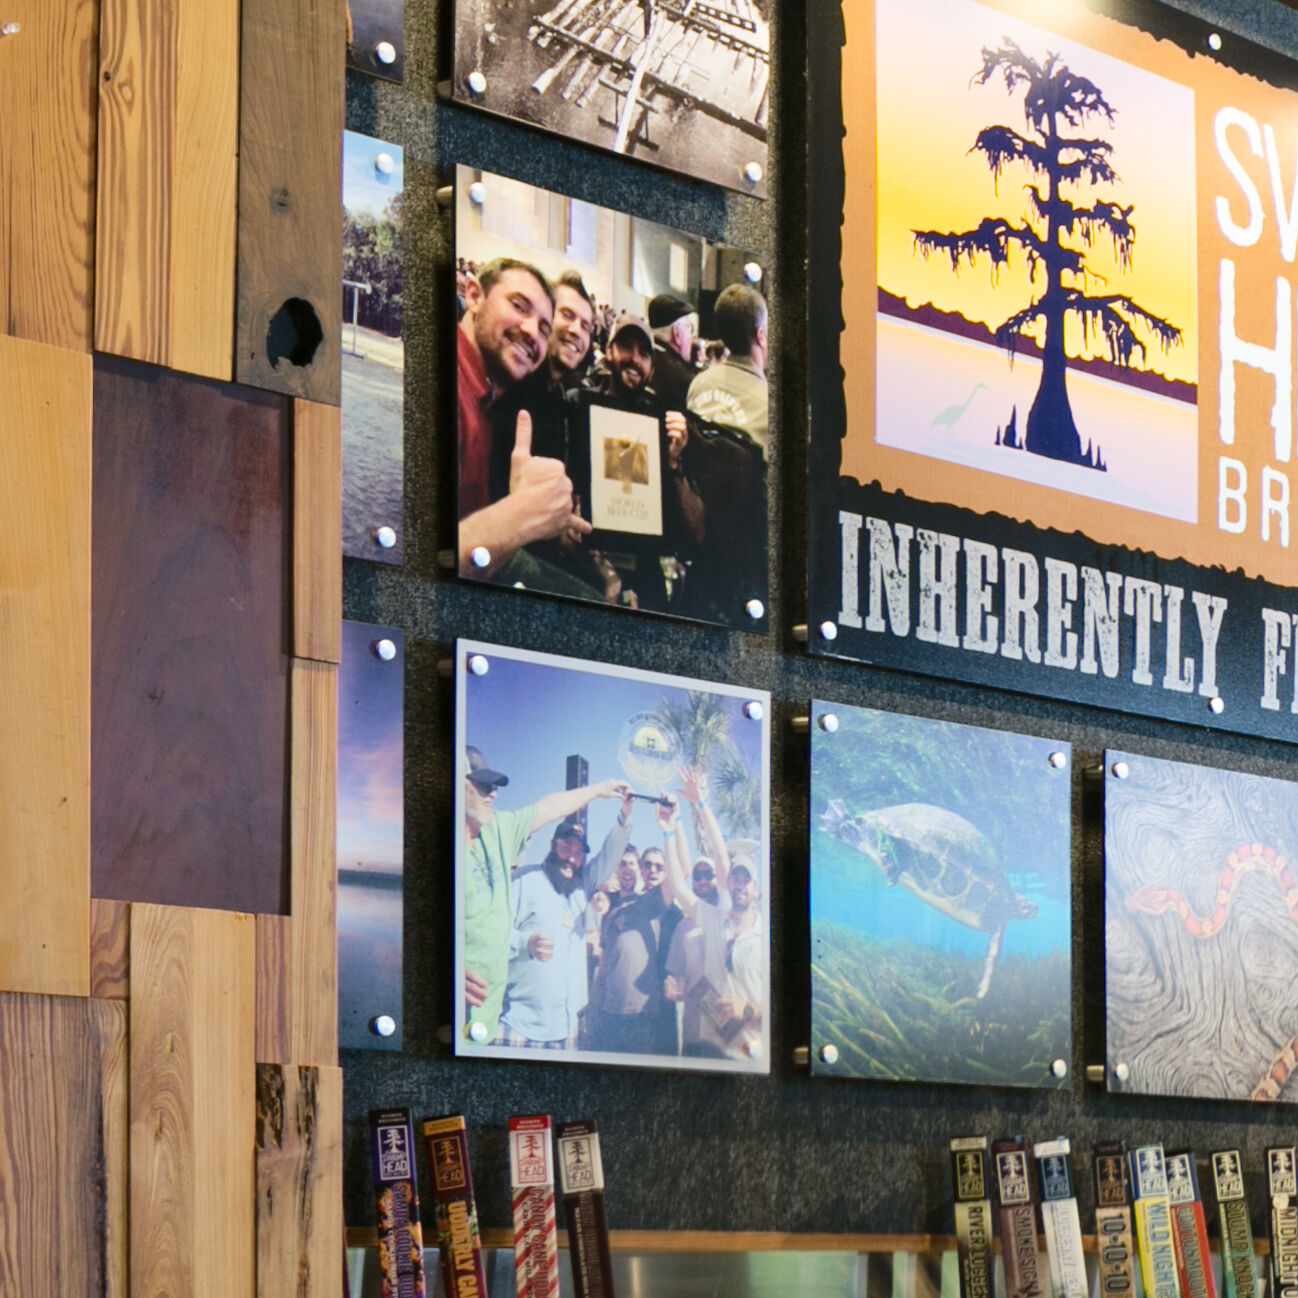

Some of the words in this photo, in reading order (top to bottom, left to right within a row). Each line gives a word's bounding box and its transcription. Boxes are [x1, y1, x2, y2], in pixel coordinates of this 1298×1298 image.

[837, 509, 1228, 699] INHERENTLY
[383, 1161, 408, 1172] HEAD
[530, 1187, 547, 1232] CANDY
[968, 1206, 984, 1247] RIVER
[1016, 1207, 1034, 1255] SMOKE
[1148, 1202, 1170, 1242] WILD
[1227, 1201, 1249, 1252] STUMP
[448, 1201, 475, 1271] UDDERLY
